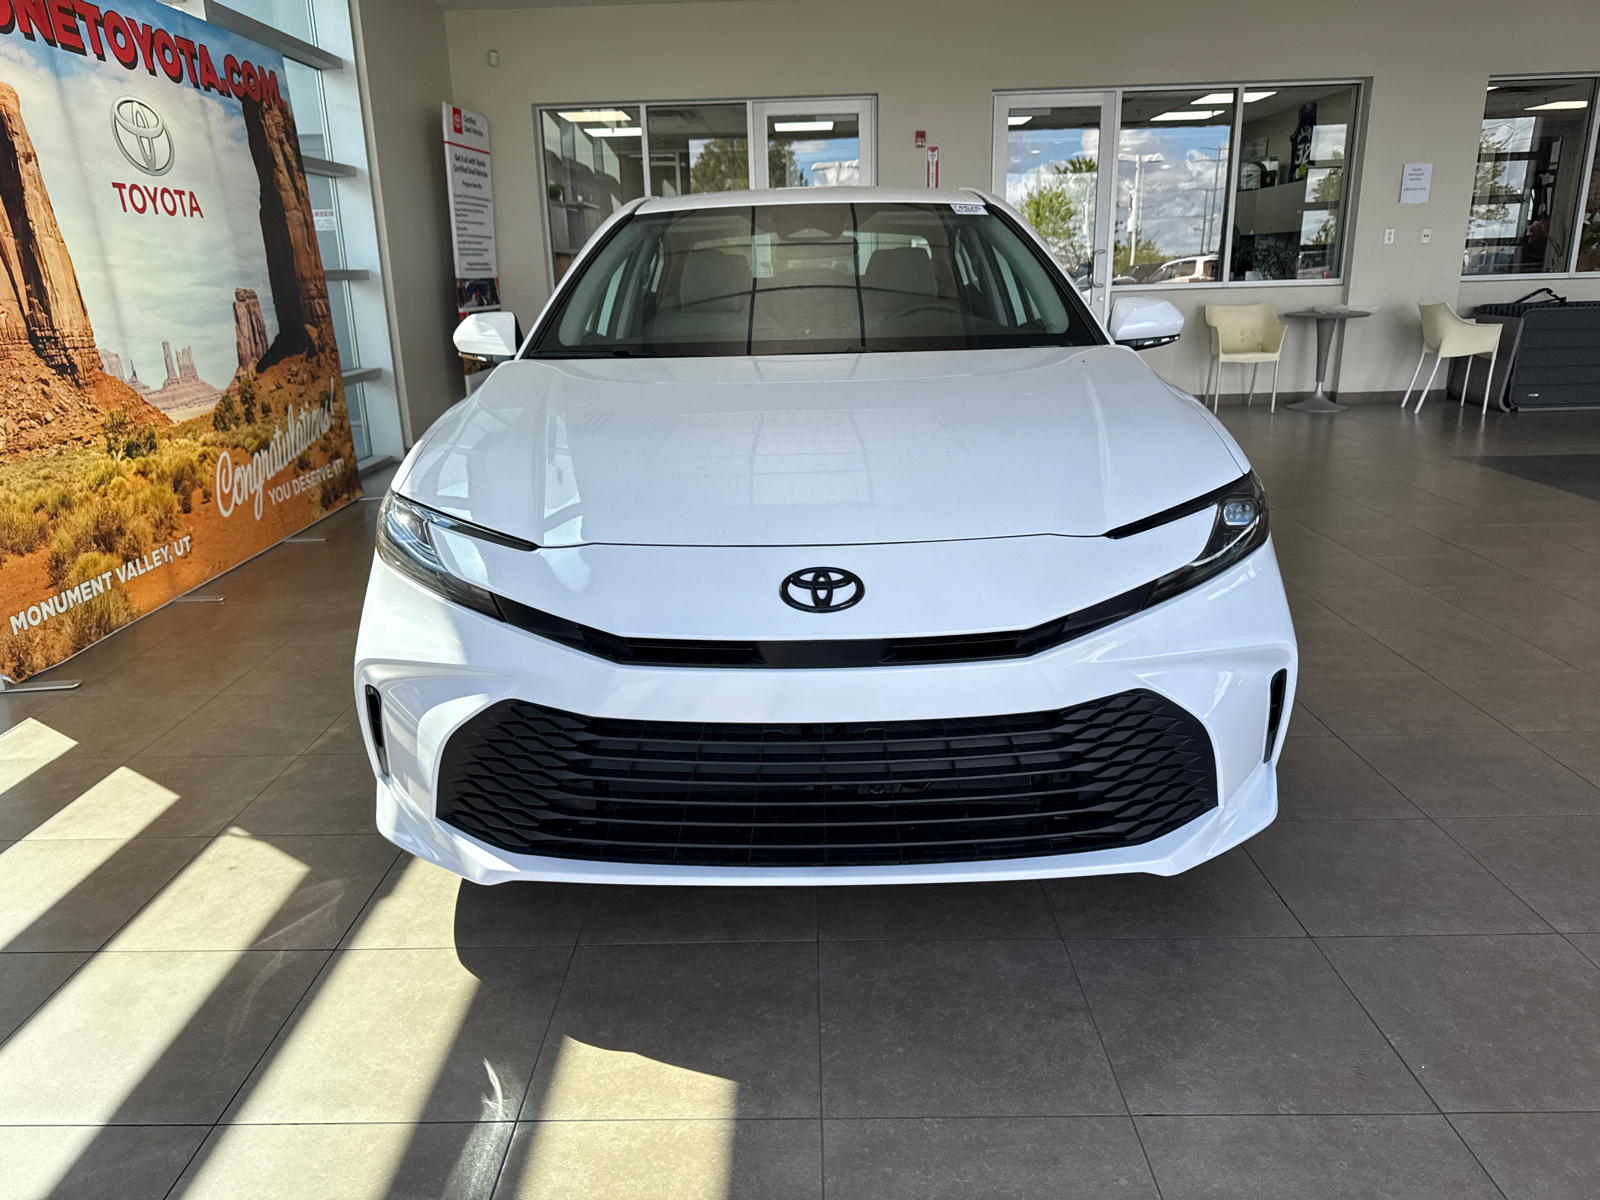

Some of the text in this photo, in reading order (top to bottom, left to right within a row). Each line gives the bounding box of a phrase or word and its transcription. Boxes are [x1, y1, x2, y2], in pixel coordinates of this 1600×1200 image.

[1295, 144, 1311, 165] 32
[112, 182, 204, 219] TOYOTA
[216, 376, 336, 521] Congratulations!
[268, 458, 345, 506] YOU DESERVE IT!
[9, 535, 191, 636] MONUMENT VALLEY, UT
